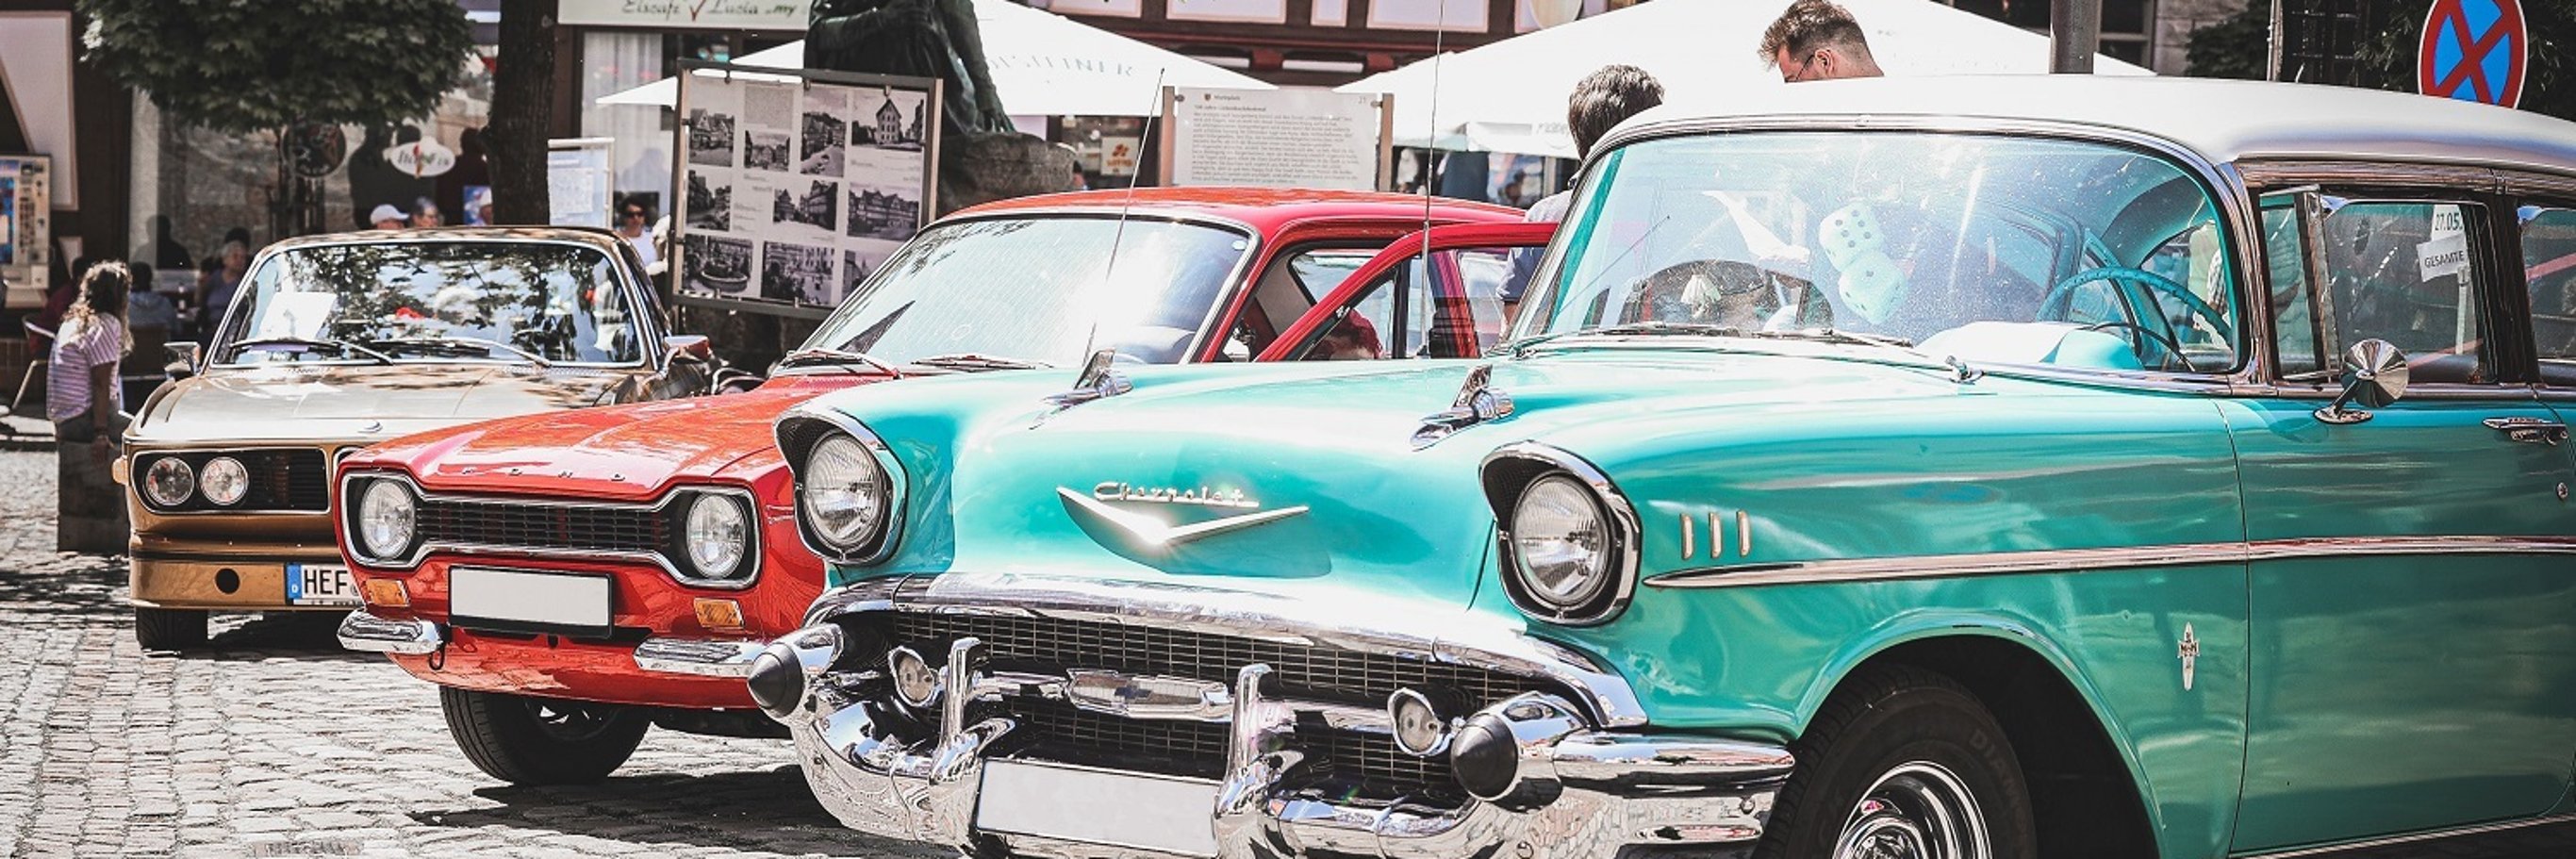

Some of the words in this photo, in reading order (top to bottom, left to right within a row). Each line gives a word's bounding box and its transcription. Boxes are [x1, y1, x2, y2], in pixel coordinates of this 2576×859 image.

[2424, 250, 2465, 269] GESAMTE
[1094, 482, 1260, 508] Chevrolet
[304, 570, 348, 595] HEF
